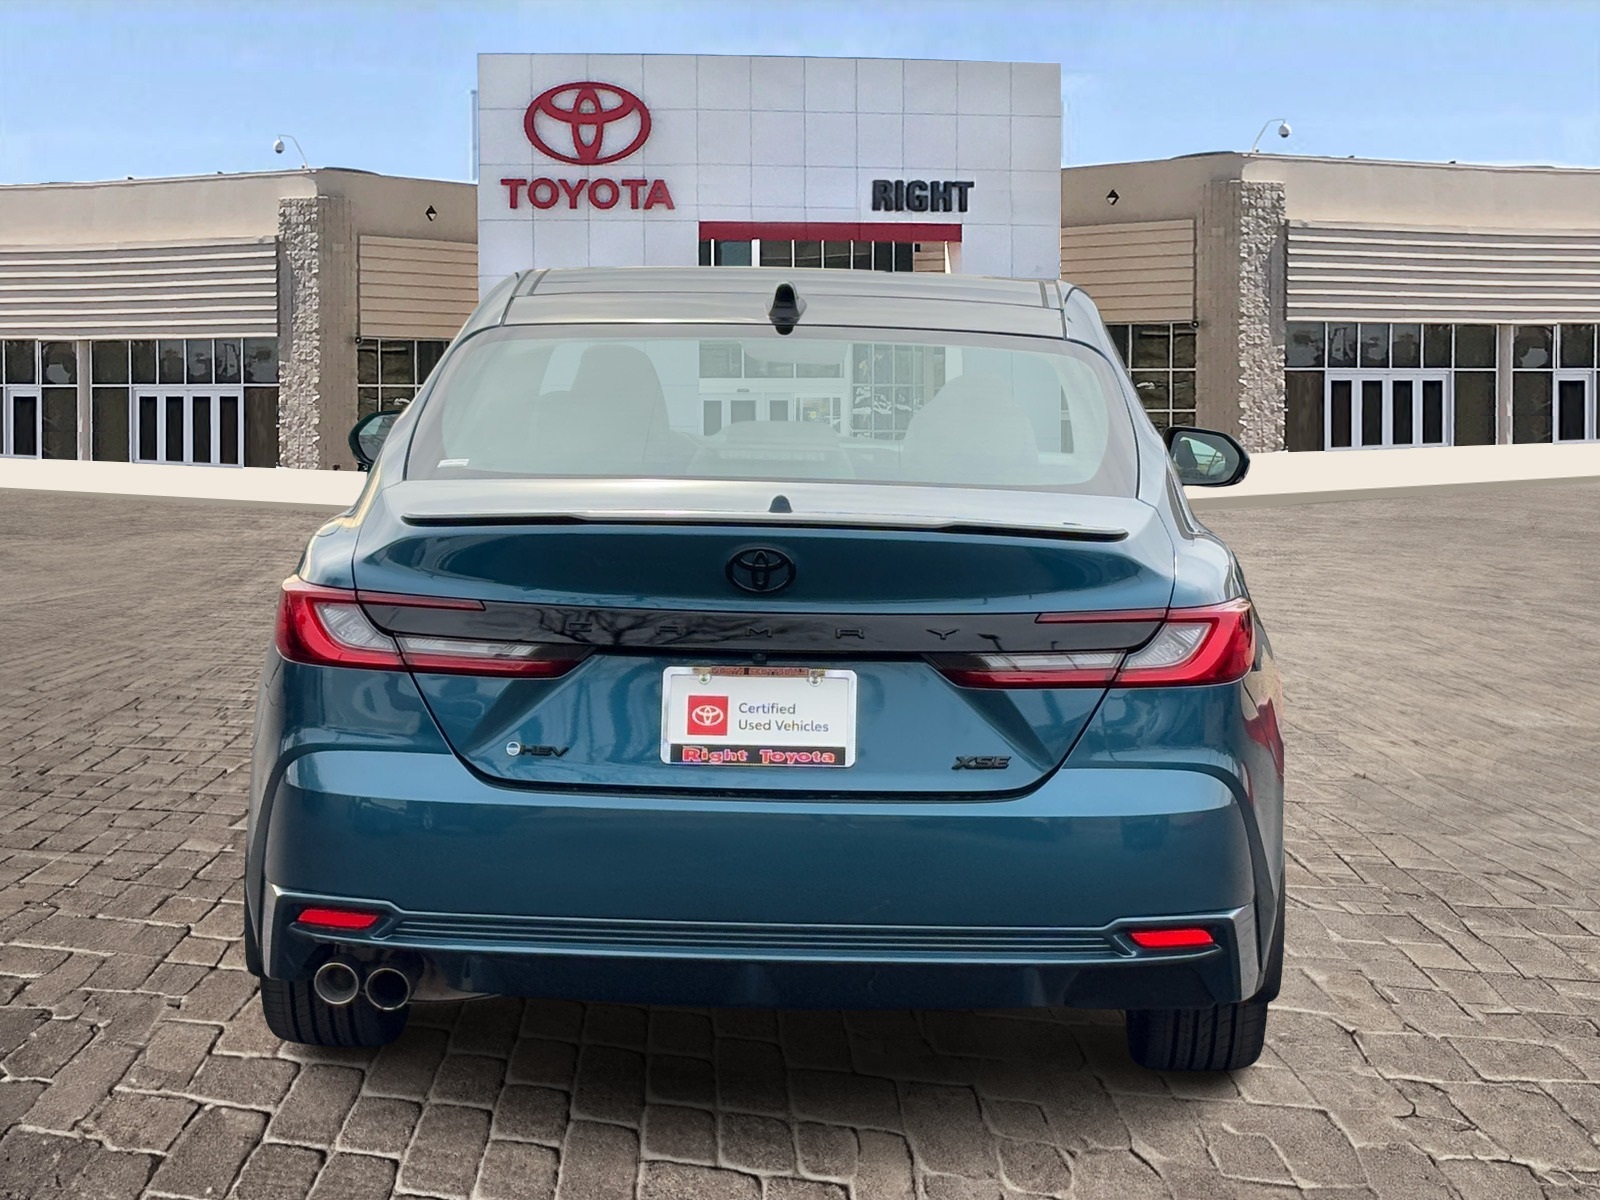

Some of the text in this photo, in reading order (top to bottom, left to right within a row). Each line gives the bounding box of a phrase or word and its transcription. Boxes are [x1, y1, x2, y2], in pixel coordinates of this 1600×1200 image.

[500, 177, 675, 210] TOYOTA
[872, 179, 975, 212] RIGHT
[738, 702, 796, 715] Certified
[738, 719, 829, 732] Used Vehicles
[682, 746, 836, 764] Right Toyota
[951, 755, 1012, 770] XSE
